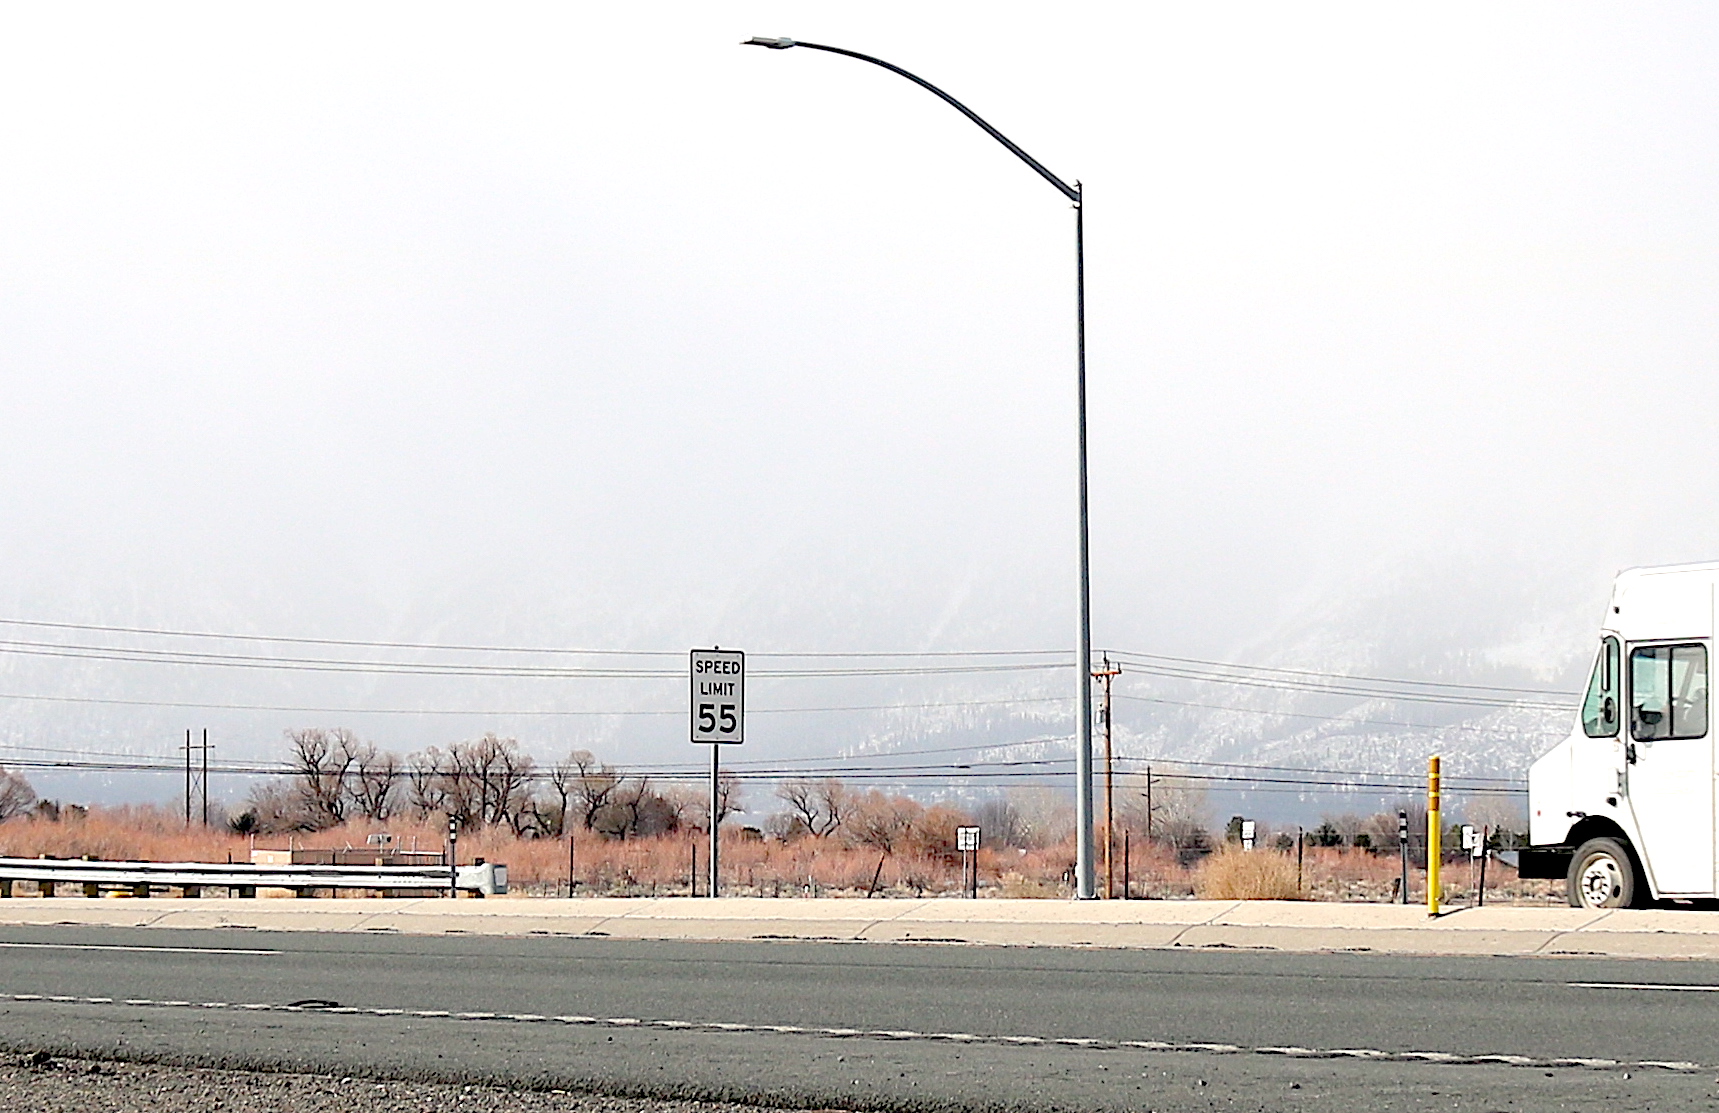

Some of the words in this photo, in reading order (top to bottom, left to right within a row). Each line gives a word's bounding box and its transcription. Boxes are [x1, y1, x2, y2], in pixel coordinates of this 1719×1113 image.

[696, 660, 741, 674] SPEED
[700, 682, 735, 696] LIMIT
[698, 703, 737, 733] 55
